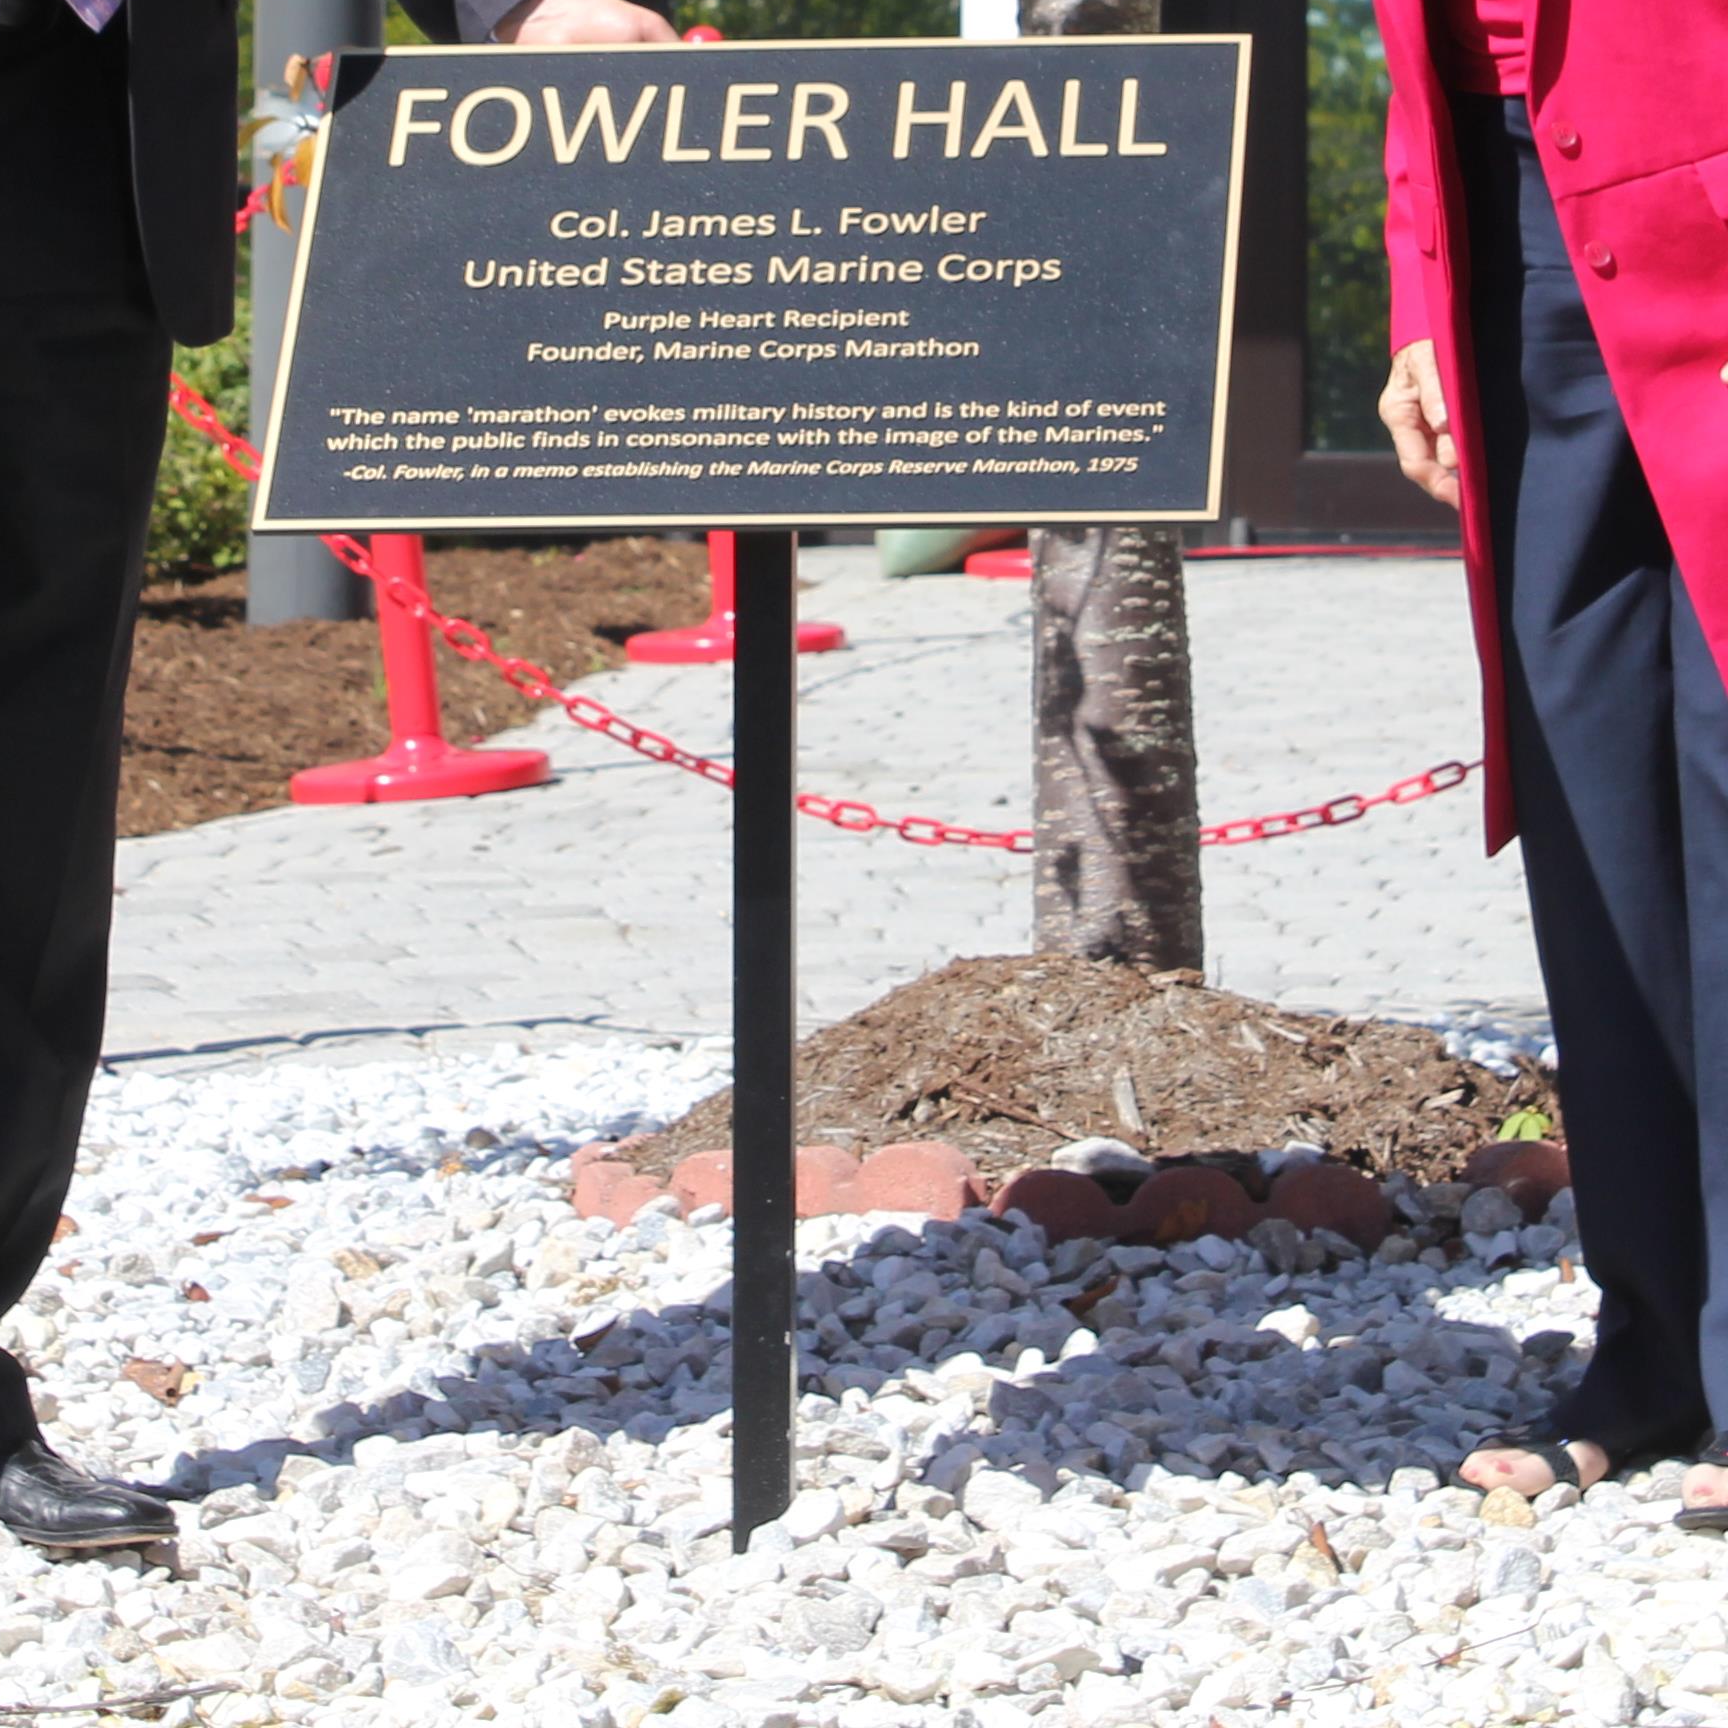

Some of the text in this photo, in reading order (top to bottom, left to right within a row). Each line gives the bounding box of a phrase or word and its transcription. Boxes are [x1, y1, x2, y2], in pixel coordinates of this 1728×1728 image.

[388, 77, 1168, 167] FOWLER HALL
[550, 204, 988, 240] Col. James L. Fowler
[464, 253, 1062, 288] United States Marine Corps
[603, 307, 911, 334] Purple Heart Recipient
[526, 337, 980, 364] Founder, Marine Corps Marathon
[390, 410, 461, 425] name
[603, 403, 687, 423] evokes
[691, 403, 787, 424] military
[791, 402, 878, 423] history
[881, 401, 928, 420] and
[933, 401, 954, 419] is
[958, 400, 1001, 419] the
[1006, 399, 1060, 418] kind
[1064, 399, 1093, 418] of
[1096, 400, 1167, 418] event
[326, 431, 400, 452] which
[404, 431, 447, 451] the
[450, 430, 527, 453] public
[531, 429, 591, 450] finds
[596, 430, 620, 448] in
[625, 432, 772, 448] consonance
[776, 427, 831, 446] with
[836, 427, 879, 446] the
[884, 427, 960, 448] image
[964, 425, 994, 444] of
[996, 425, 1039, 445] the
[392, 463, 465, 482] Fowler,
[469, 463, 491, 479] in
[493, 465, 510, 479] a
[512, 464, 579, 479] memo
[581, 460, 704, 480] establishing
[708, 460, 744, 477] the
[746, 459, 823, 476] Marine
[825, 459, 885, 478] Corps
[887, 458, 969, 475] Reserve
[971, 457, 1081, 475] Marathon,
[1086, 456, 1139, 473] 1975
